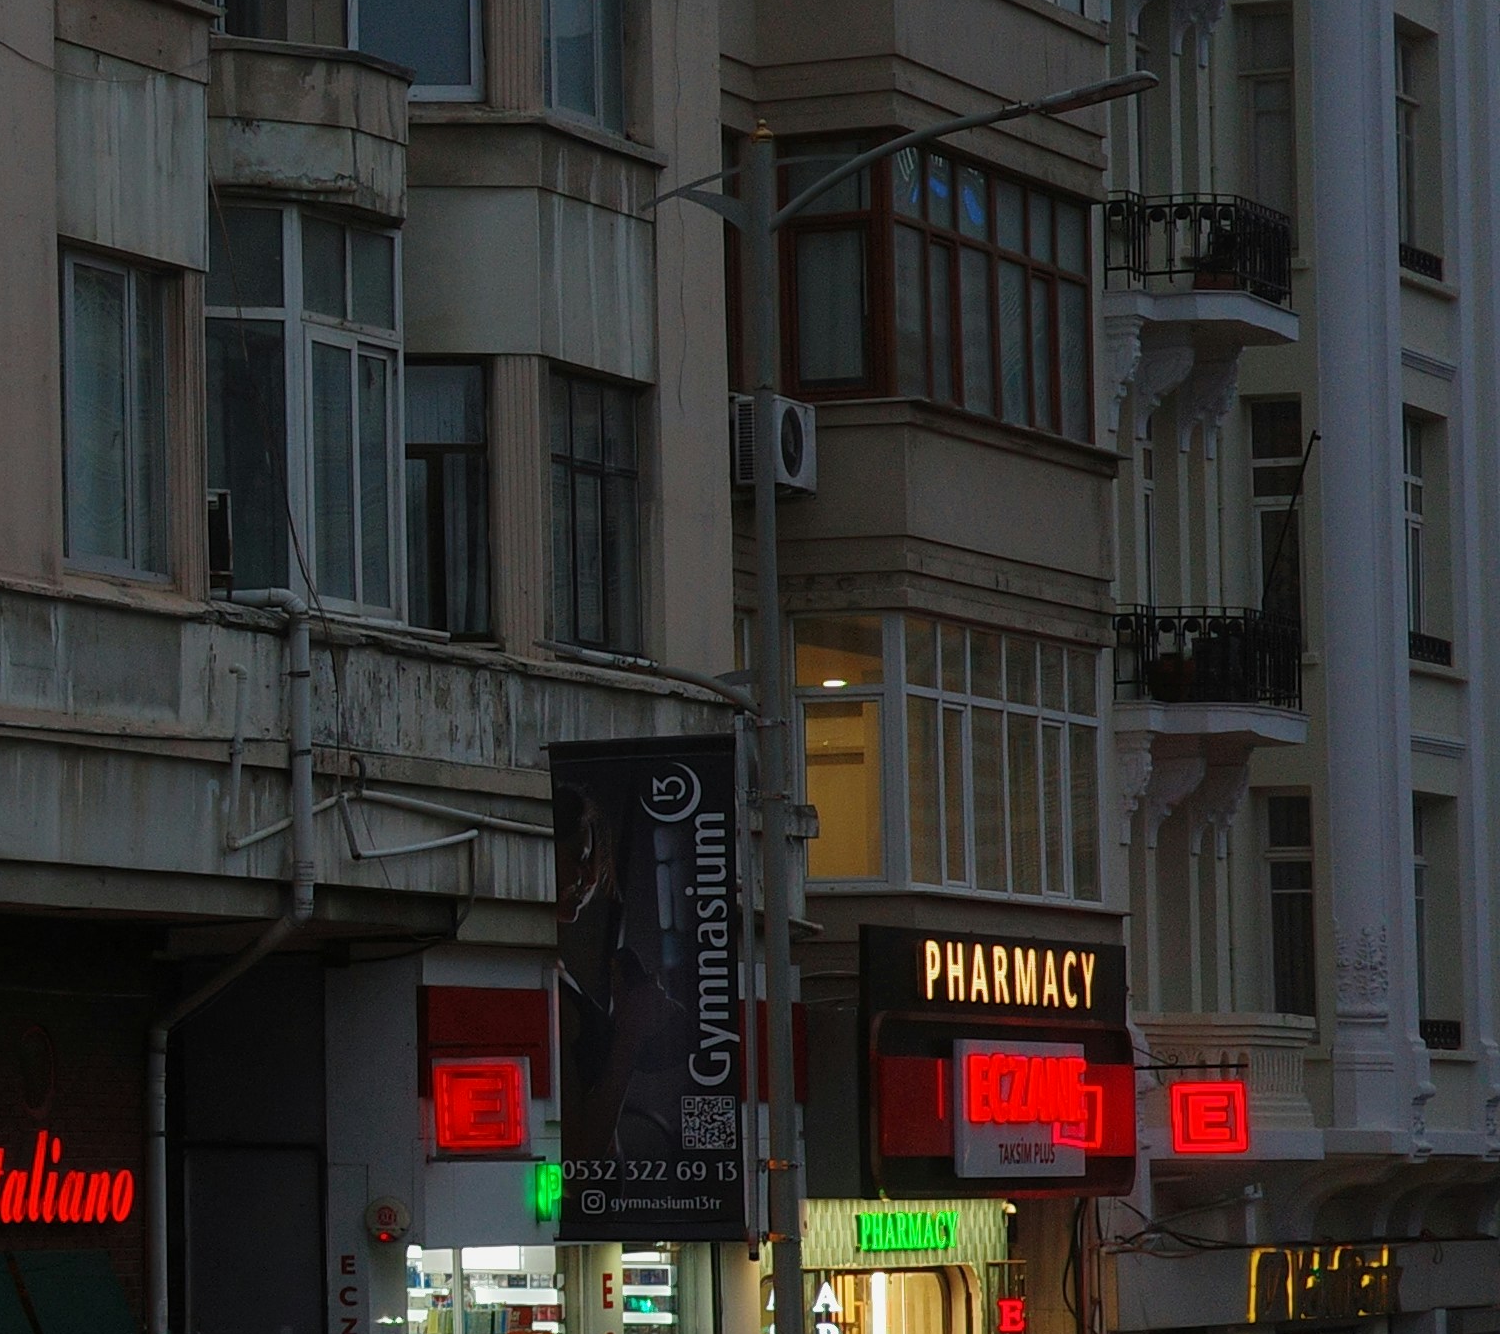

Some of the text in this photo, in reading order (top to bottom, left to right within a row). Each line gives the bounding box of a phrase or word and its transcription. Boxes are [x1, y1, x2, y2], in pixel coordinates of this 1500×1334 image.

[688, 812, 741, 1087] Gymnasium
[924, 940, 1095, 1009] PHARMACY
[969, 1053, 1087, 1124] ECZANE
[562, 1160, 738, 1182] 0532 322 69 13
[999, 1137, 1055, 1164] TAKSİM PLUS
[610, 1195, 723, 1212] gymnasium13tr
[859, 1211, 959, 1252] PHARMACY
